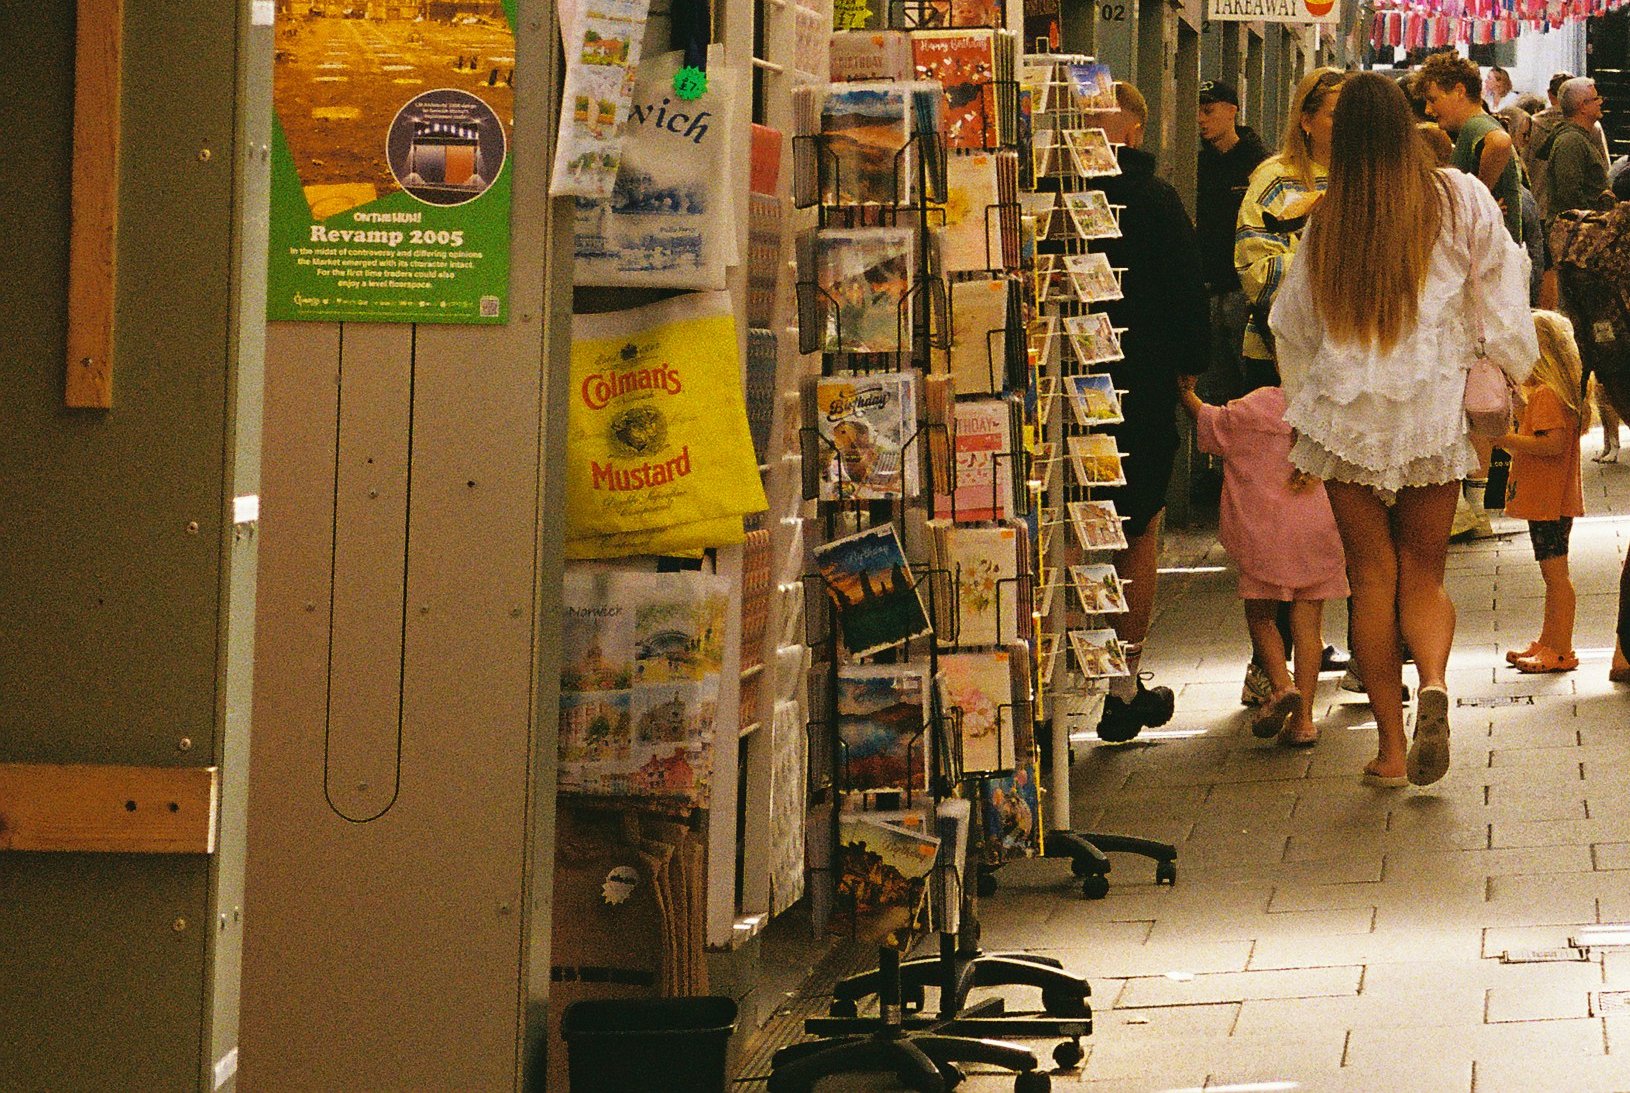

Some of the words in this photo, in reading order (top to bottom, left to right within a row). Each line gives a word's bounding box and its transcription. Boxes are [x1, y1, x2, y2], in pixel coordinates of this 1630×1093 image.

[310, 225, 404, 247] Revamp
[409, 229, 464, 247] 2005
[582, 363, 682, 410] Colman's
[591, 446, 692, 491] Mustard
